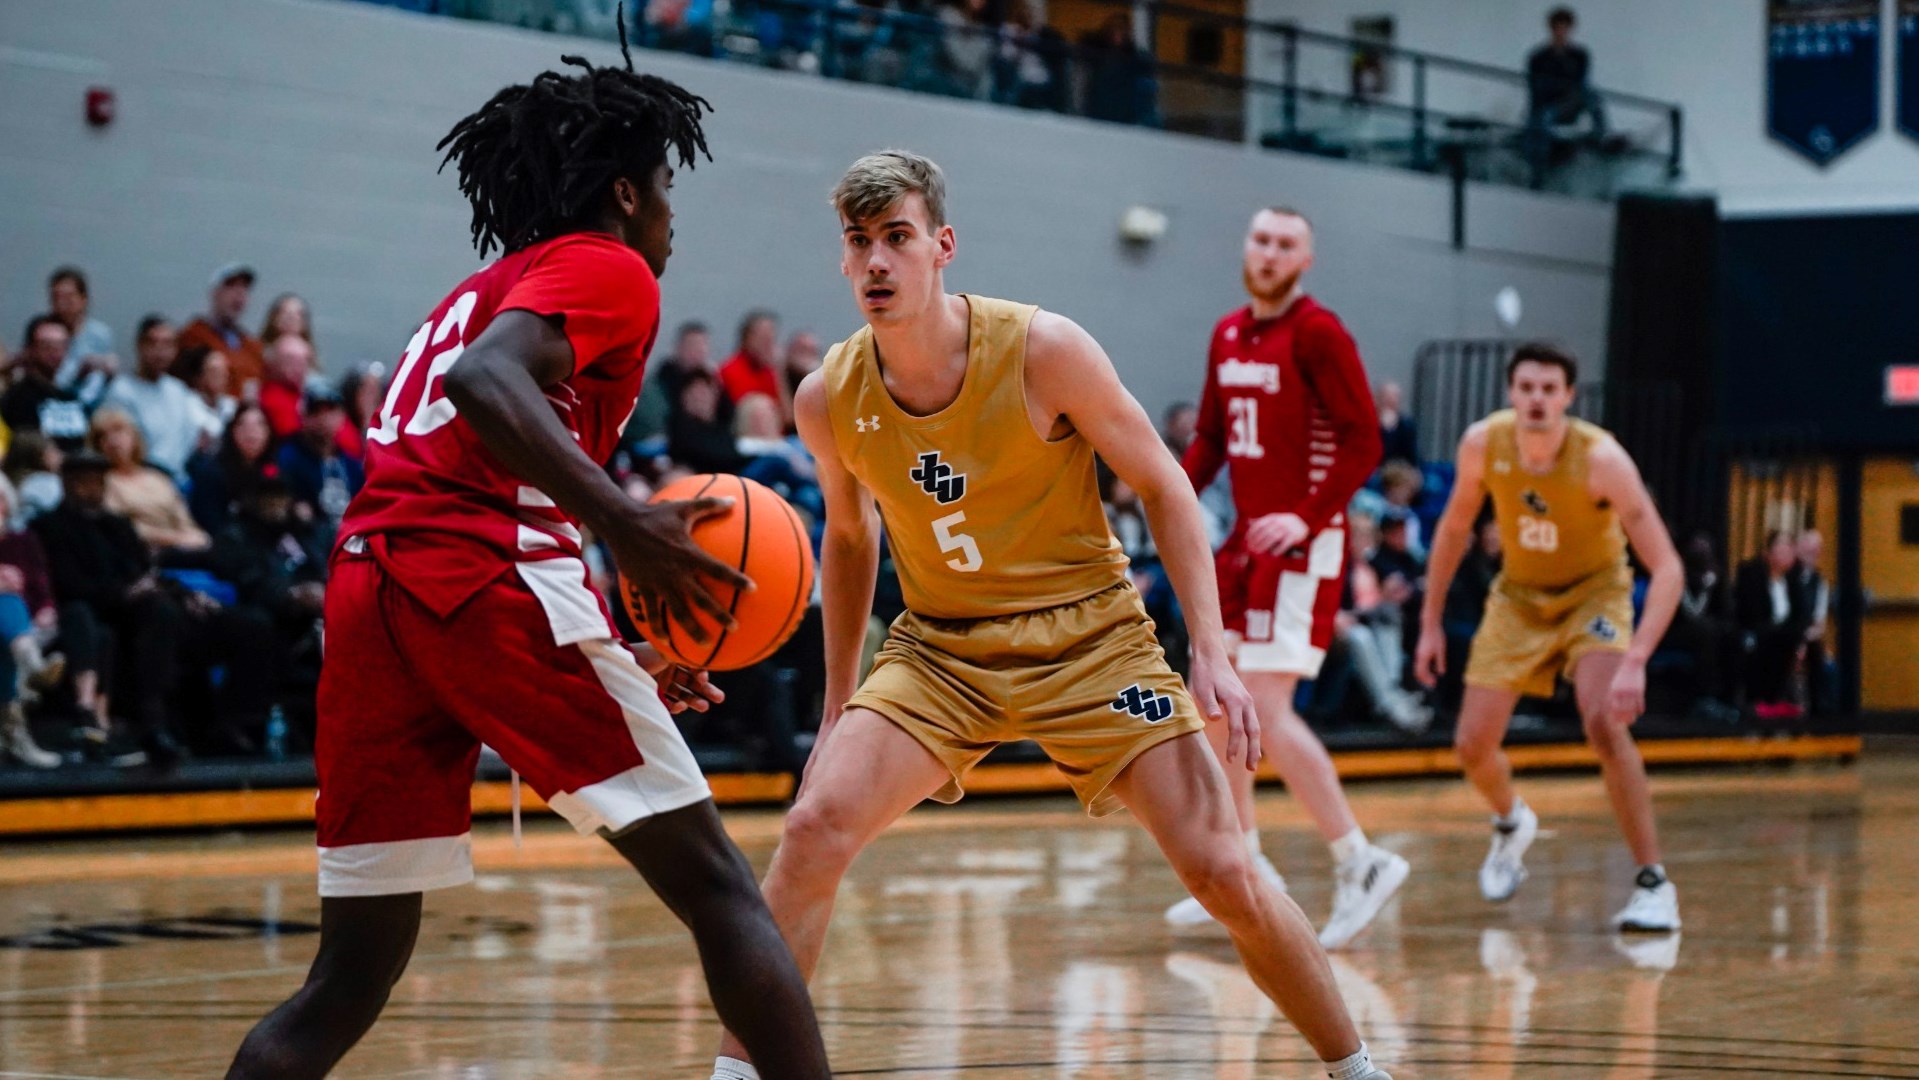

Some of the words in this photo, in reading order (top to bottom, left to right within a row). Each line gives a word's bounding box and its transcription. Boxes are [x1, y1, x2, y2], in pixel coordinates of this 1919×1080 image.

[366, 290, 478, 446] 12
[1227, 396, 1265, 459] 31
[909, 450, 967, 506] JCU
[931, 510, 983, 573] 5
[1517, 515, 1559, 553] 20
[1109, 682, 1174, 725] JCU
